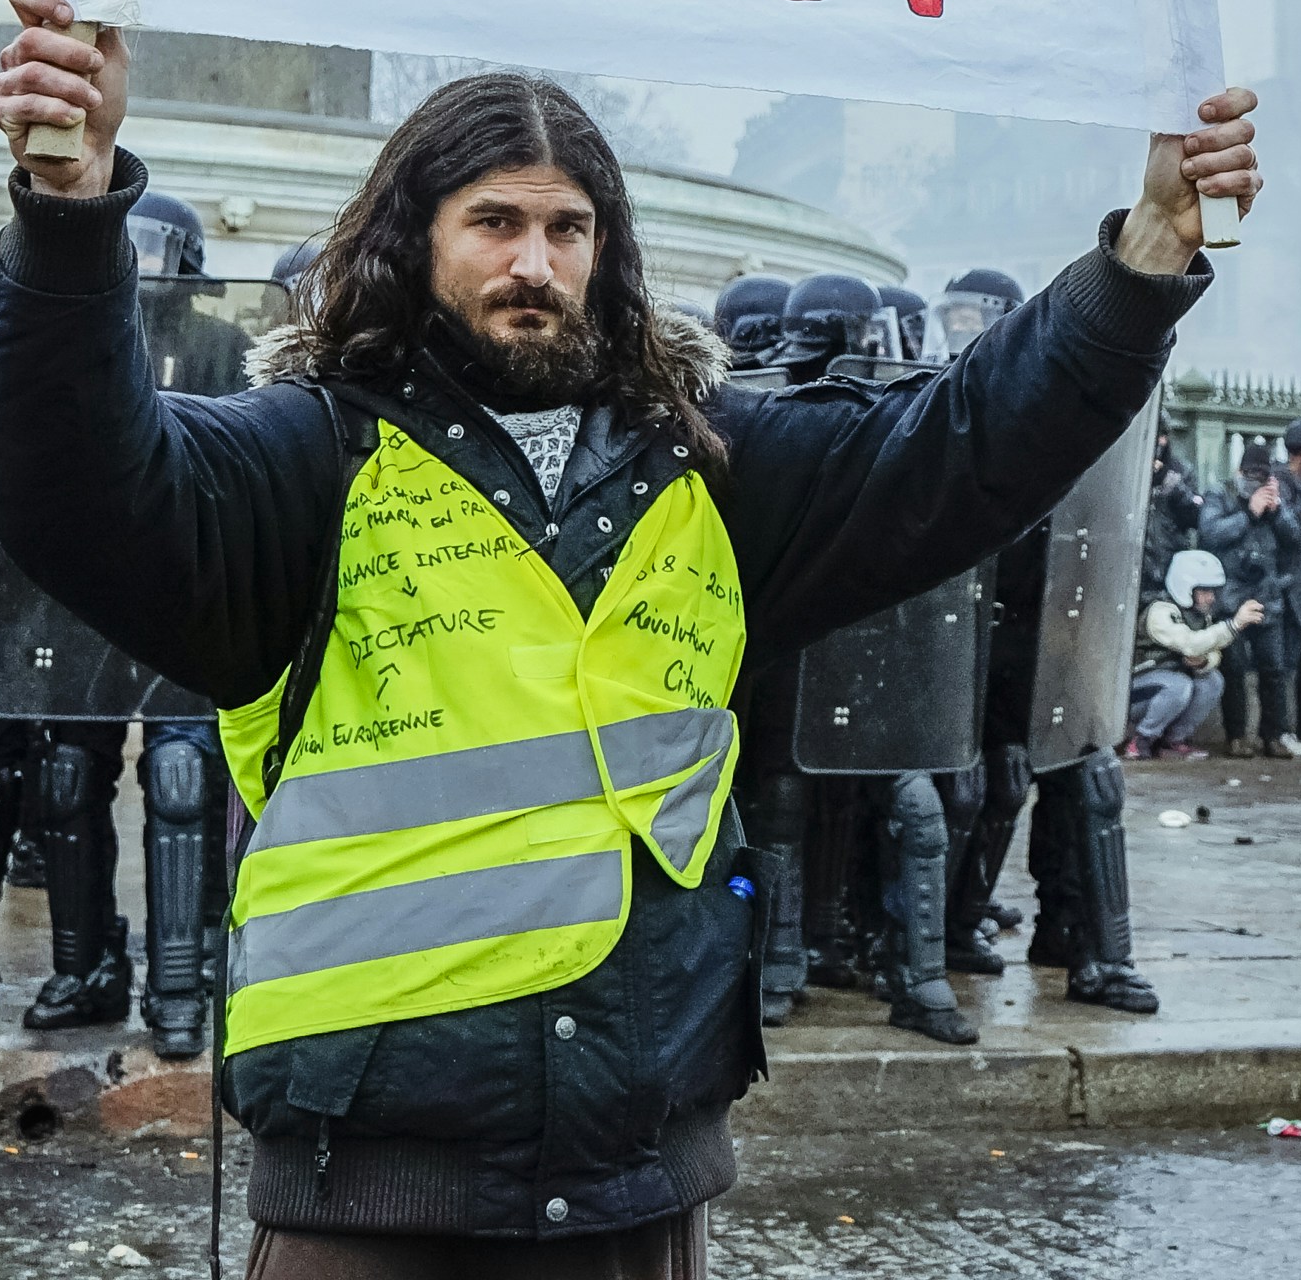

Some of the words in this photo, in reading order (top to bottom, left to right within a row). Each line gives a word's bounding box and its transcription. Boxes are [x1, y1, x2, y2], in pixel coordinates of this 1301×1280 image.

[430, 508, 453, 529] EN
[705, 571, 740, 617] 2019
[349, 608, 506, 670] DICTATURE
